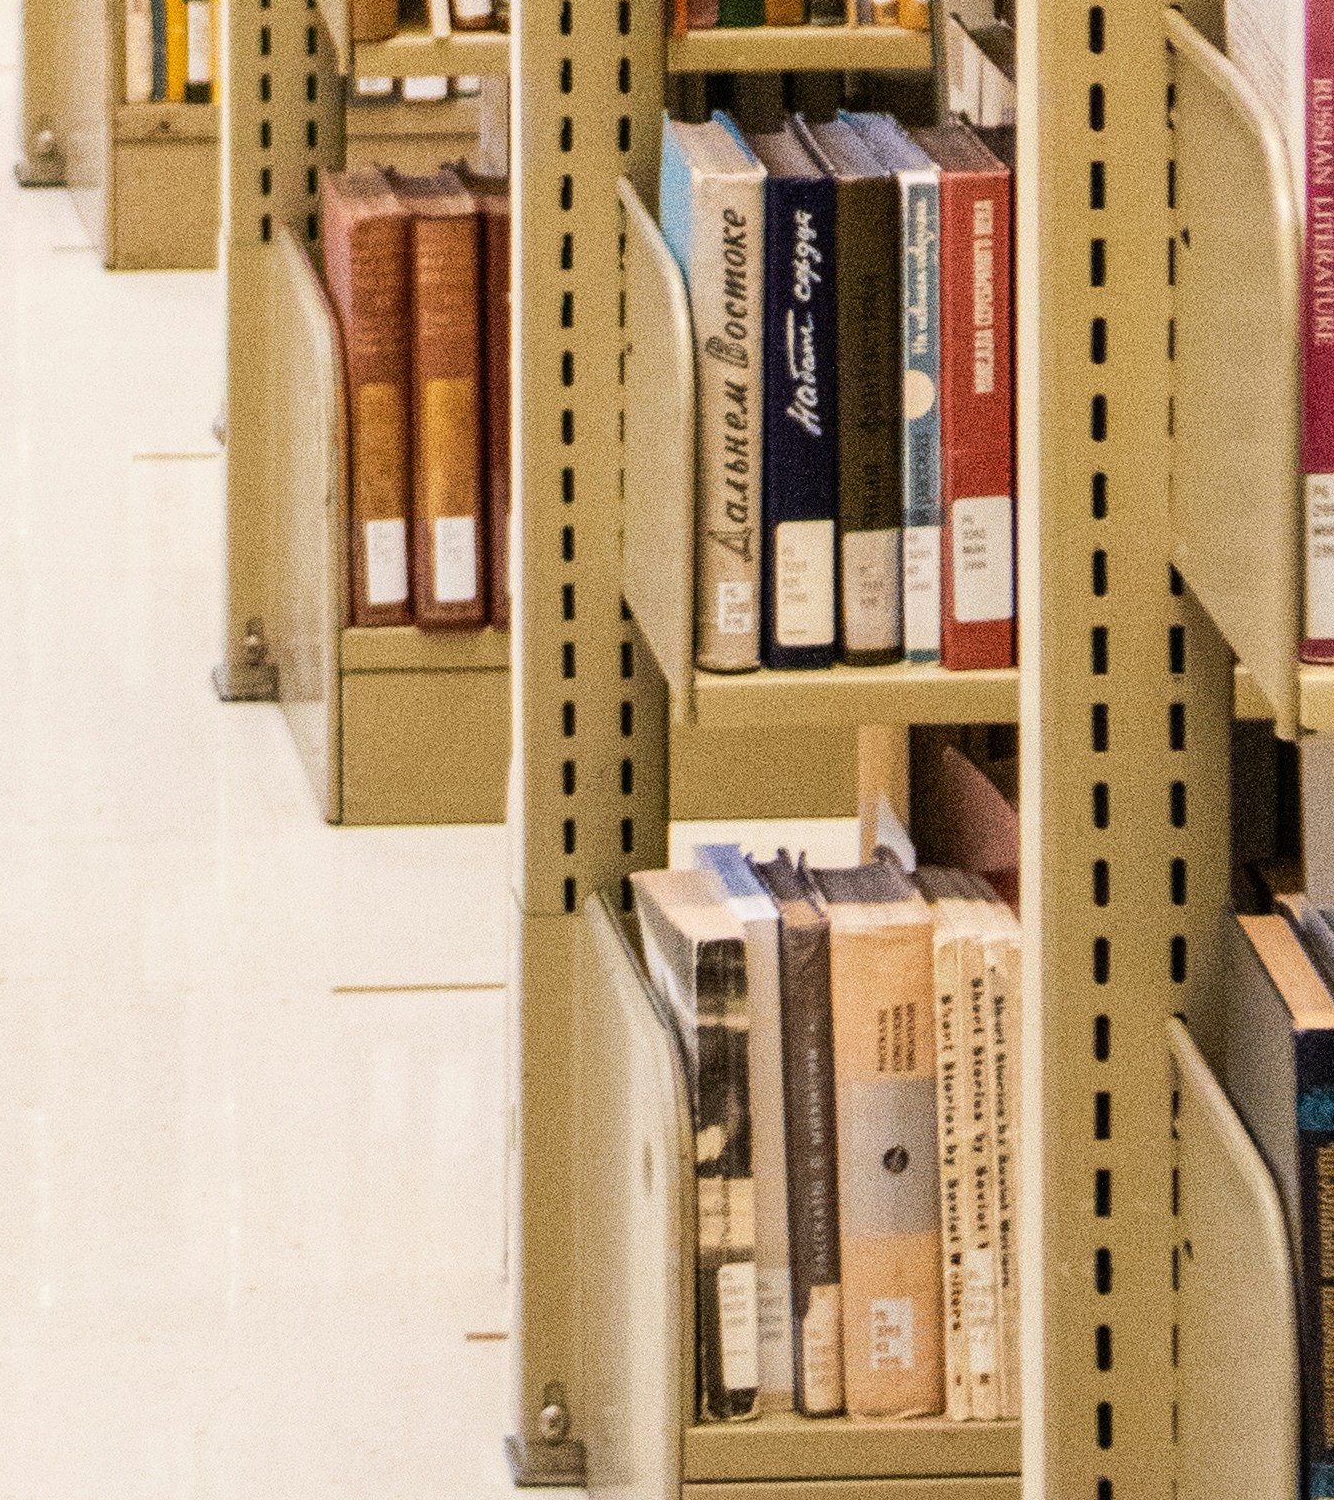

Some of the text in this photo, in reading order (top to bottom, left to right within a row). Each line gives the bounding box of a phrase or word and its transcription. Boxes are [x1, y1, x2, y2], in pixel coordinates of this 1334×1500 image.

[703, 207, 755, 563] Дальнем Востоке
[942, 1060, 959, 1138] Stories
